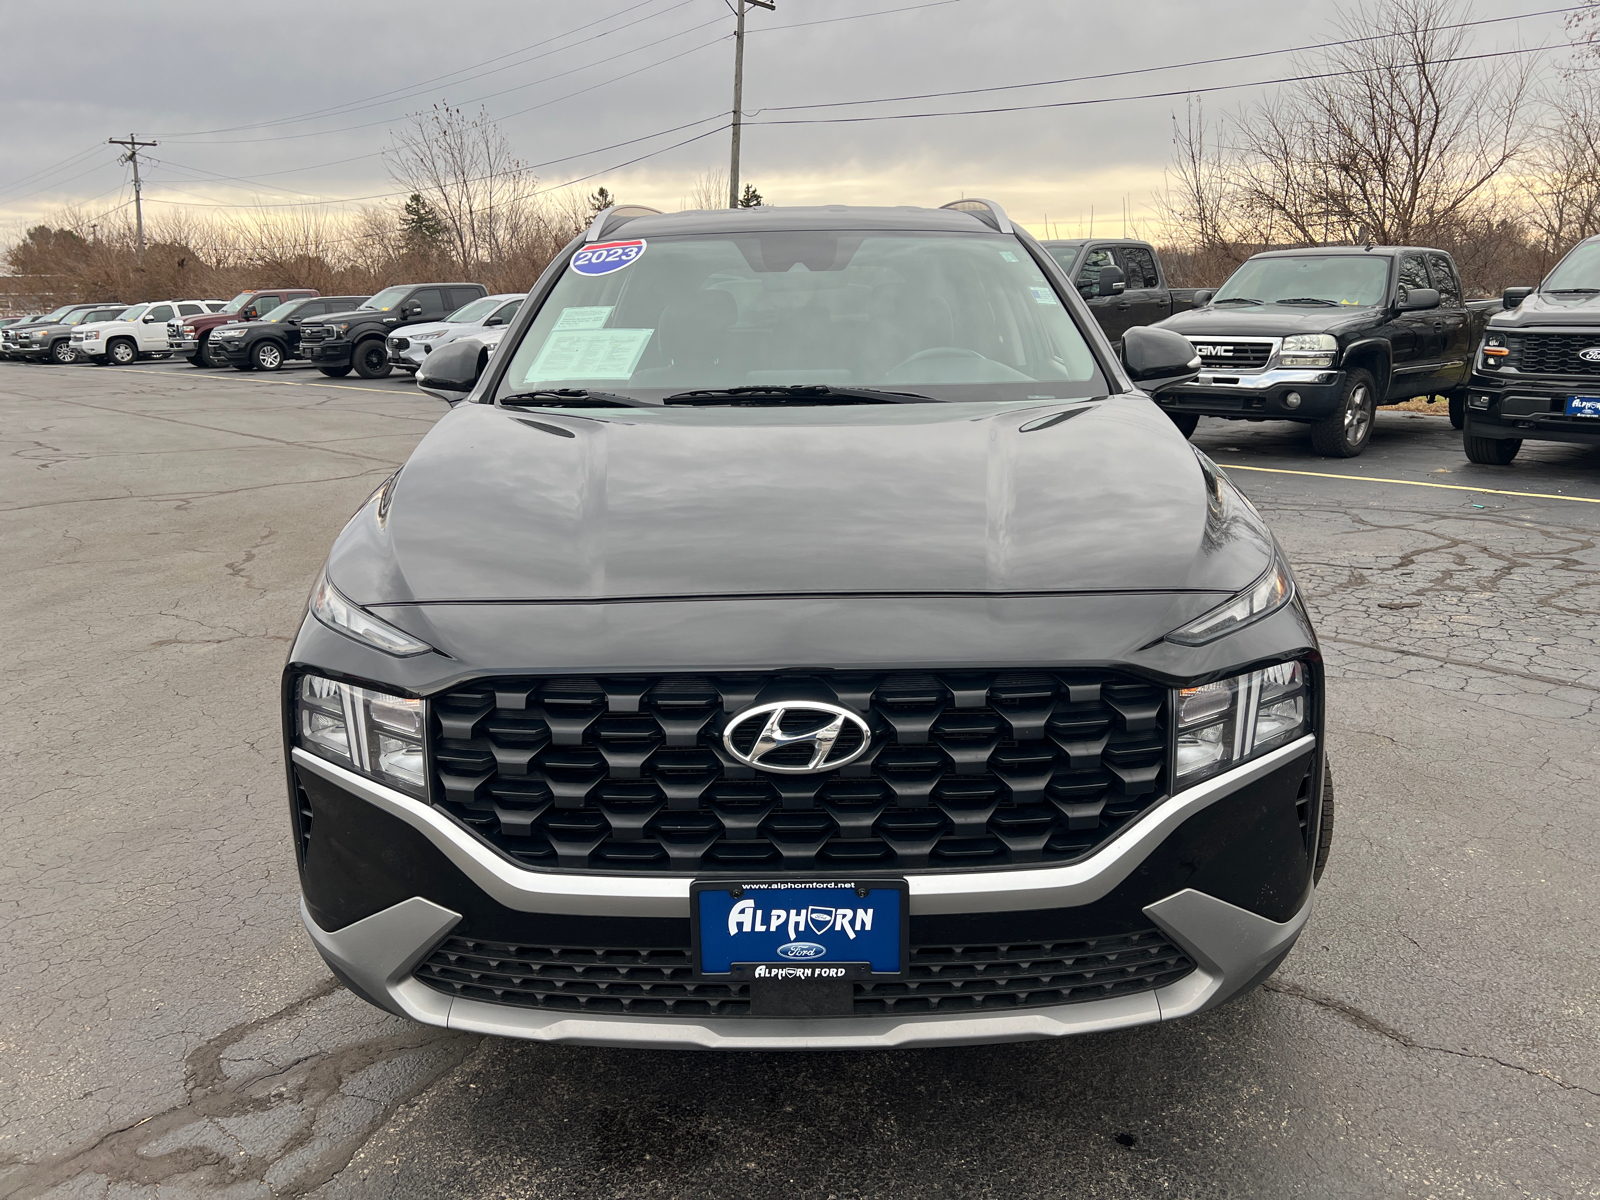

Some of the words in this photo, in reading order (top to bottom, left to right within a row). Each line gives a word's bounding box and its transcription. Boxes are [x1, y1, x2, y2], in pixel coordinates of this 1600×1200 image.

[574, 247, 639, 265] 2023
[1197, 345, 1234, 356] GMC
[1572, 399, 1600, 410] ALPHOR
[742, 882, 855, 890] www.alphornford.net
[728, 899, 874, 941] ALPHORN
[787, 945, 816, 957] Ford
[755, 965, 812, 980] ALPHORN
[814, 968, 846, 978] FORD
